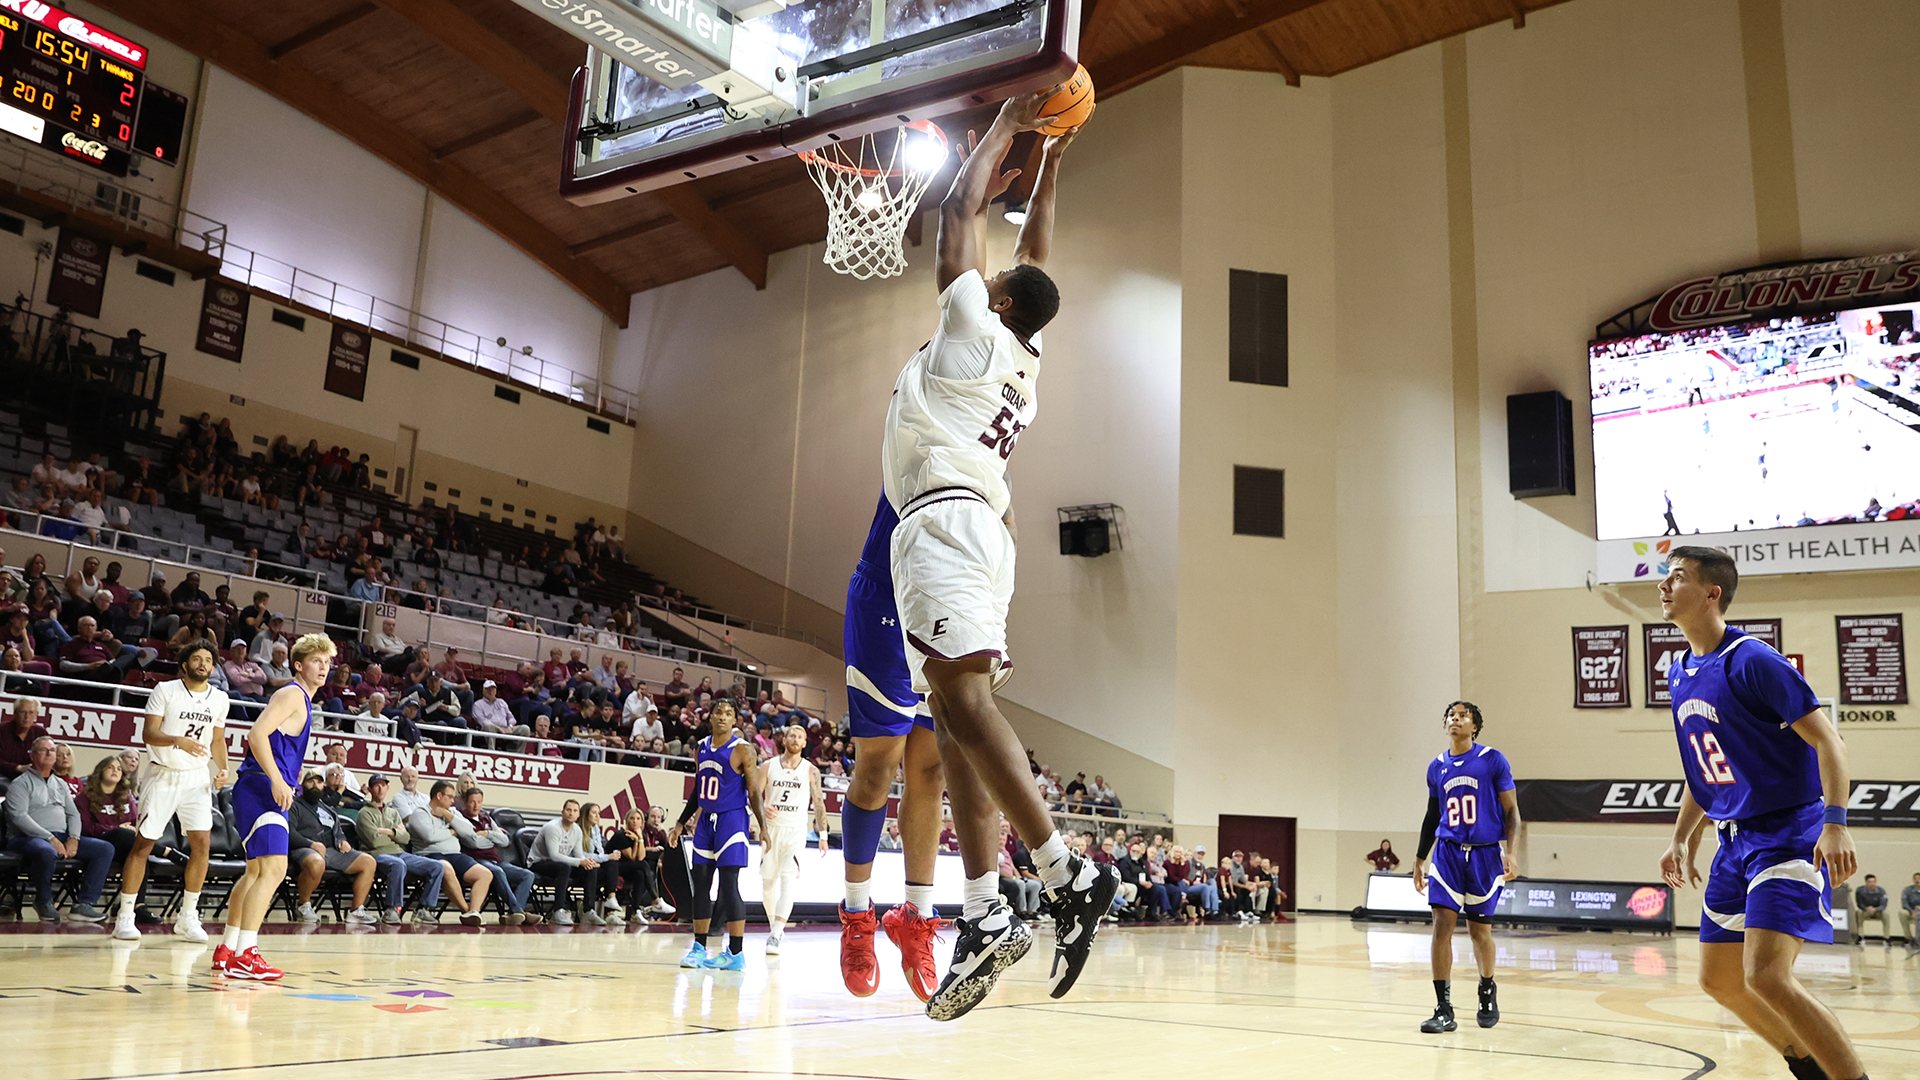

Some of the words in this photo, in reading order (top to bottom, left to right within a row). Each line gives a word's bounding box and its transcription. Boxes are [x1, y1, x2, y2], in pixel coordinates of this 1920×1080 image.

[35, 29, 89, 70] 15:54
[66, 70, 73, 86] 1
[12, 80, 37, 104] 20
[41, 92, 55, 111] 0
[120, 83, 135, 107] 2
[70, 104, 82, 122] 2
[91, 113, 101, 128] 3
[118, 123, 131, 141] 0
[1650, 261, 1920, 331] COLONELS
[1788, 536, 1889, 560] HEALTH
[1899, 535, 1920, 553] A
[307, 592, 327, 605] 214
[376, 604, 396, 617] 215
[932, 617, 949, 638] E
[1580, 656, 1621, 679] 627
[179, 711, 213, 723] EASTERN
[185, 724, 205, 740] 24
[366, 741, 565, 786] UNIVERSITY
[1688, 731, 1737, 784] 12
[700, 775, 719, 800] 10
[773, 780, 801, 789] EASTERN
[780, 790, 790, 802] 5
[1446, 794, 1477, 828] 20
[1528, 889, 1556, 900] BEREA
[1570, 891, 1617, 903] LEXINGTON
